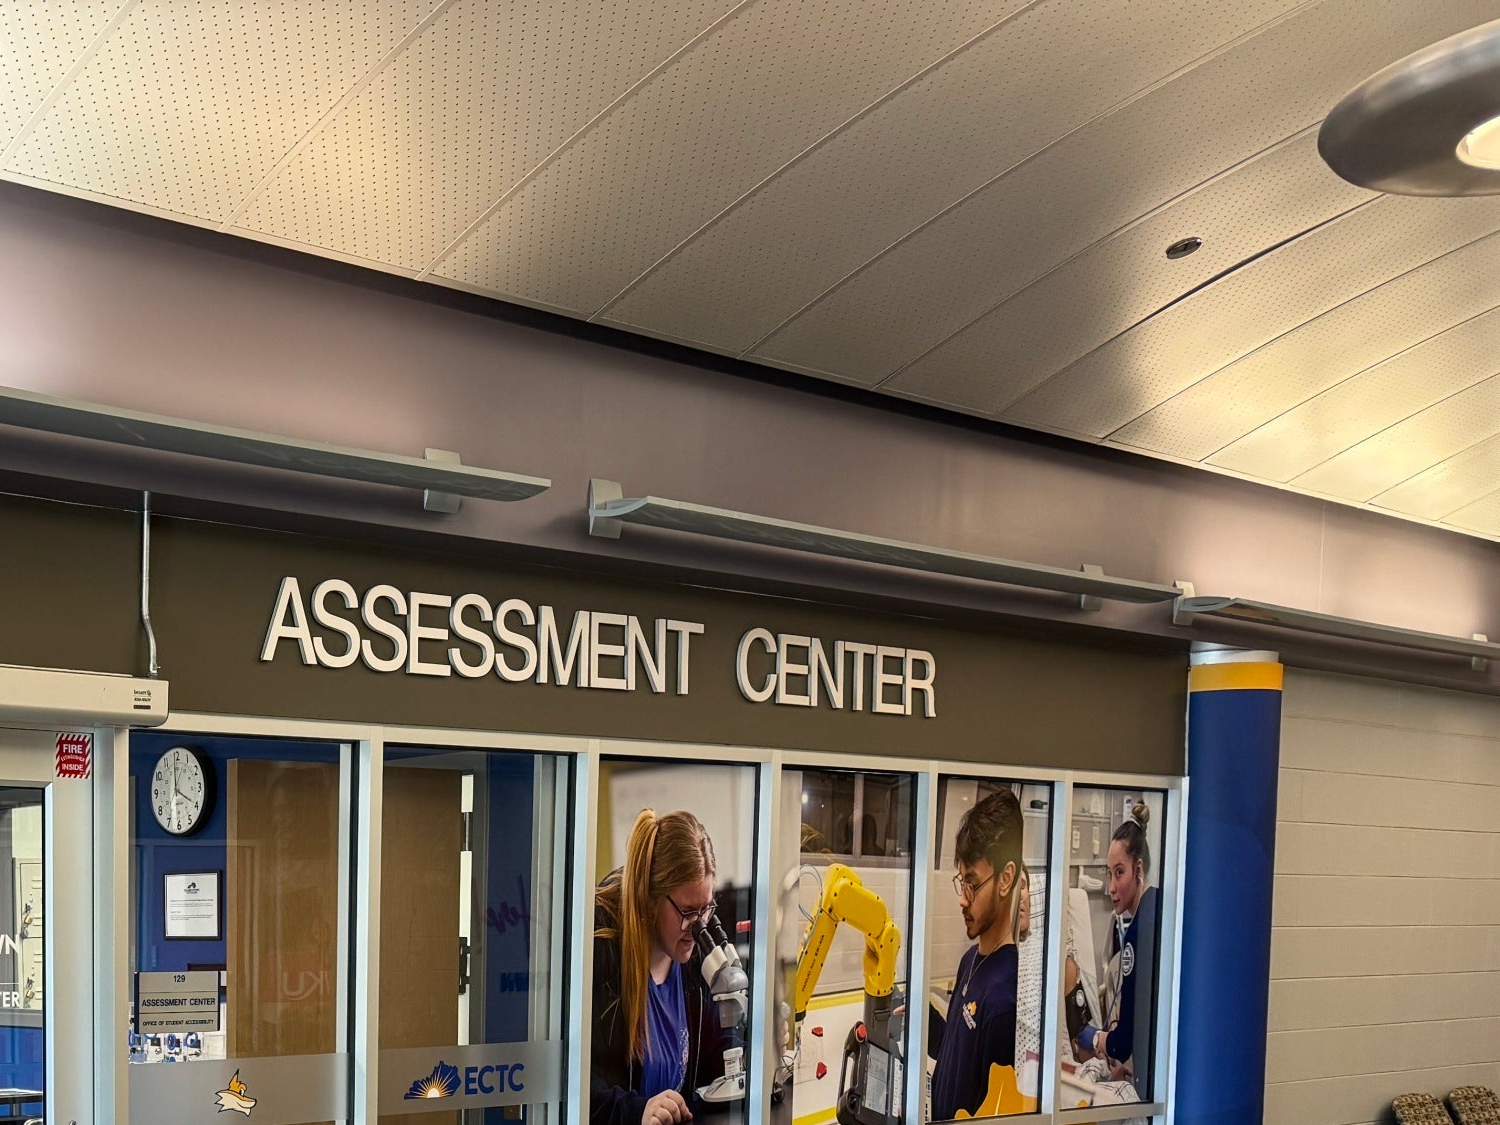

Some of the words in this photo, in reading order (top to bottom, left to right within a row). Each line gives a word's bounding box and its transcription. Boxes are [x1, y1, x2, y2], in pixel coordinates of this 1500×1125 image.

[261, 576, 704, 695] ASSESSMENT
[736, 627, 937, 718] CENTER
[63, 743, 83, 753] FIRE
[61, 763, 84, 771] INSIDE
[194, 765, 198, 776] 2
[156, 772, 162, 782] 10
[197, 782, 202, 793] 3
[154, 789, 159, 799] 9
[158, 805, 163, 816] 8
[194, 801, 199, 811] 4
[167, 817, 171, 828] 7
[177, 820, 182, 830] 6
[188, 815, 193, 825] 5
[174, 975, 186, 983] 129
[142, 998, 187, 1007] ASSESSMENT
[190, 998, 216, 1006] CENTER
[464, 1063, 525, 1095] ECTC
